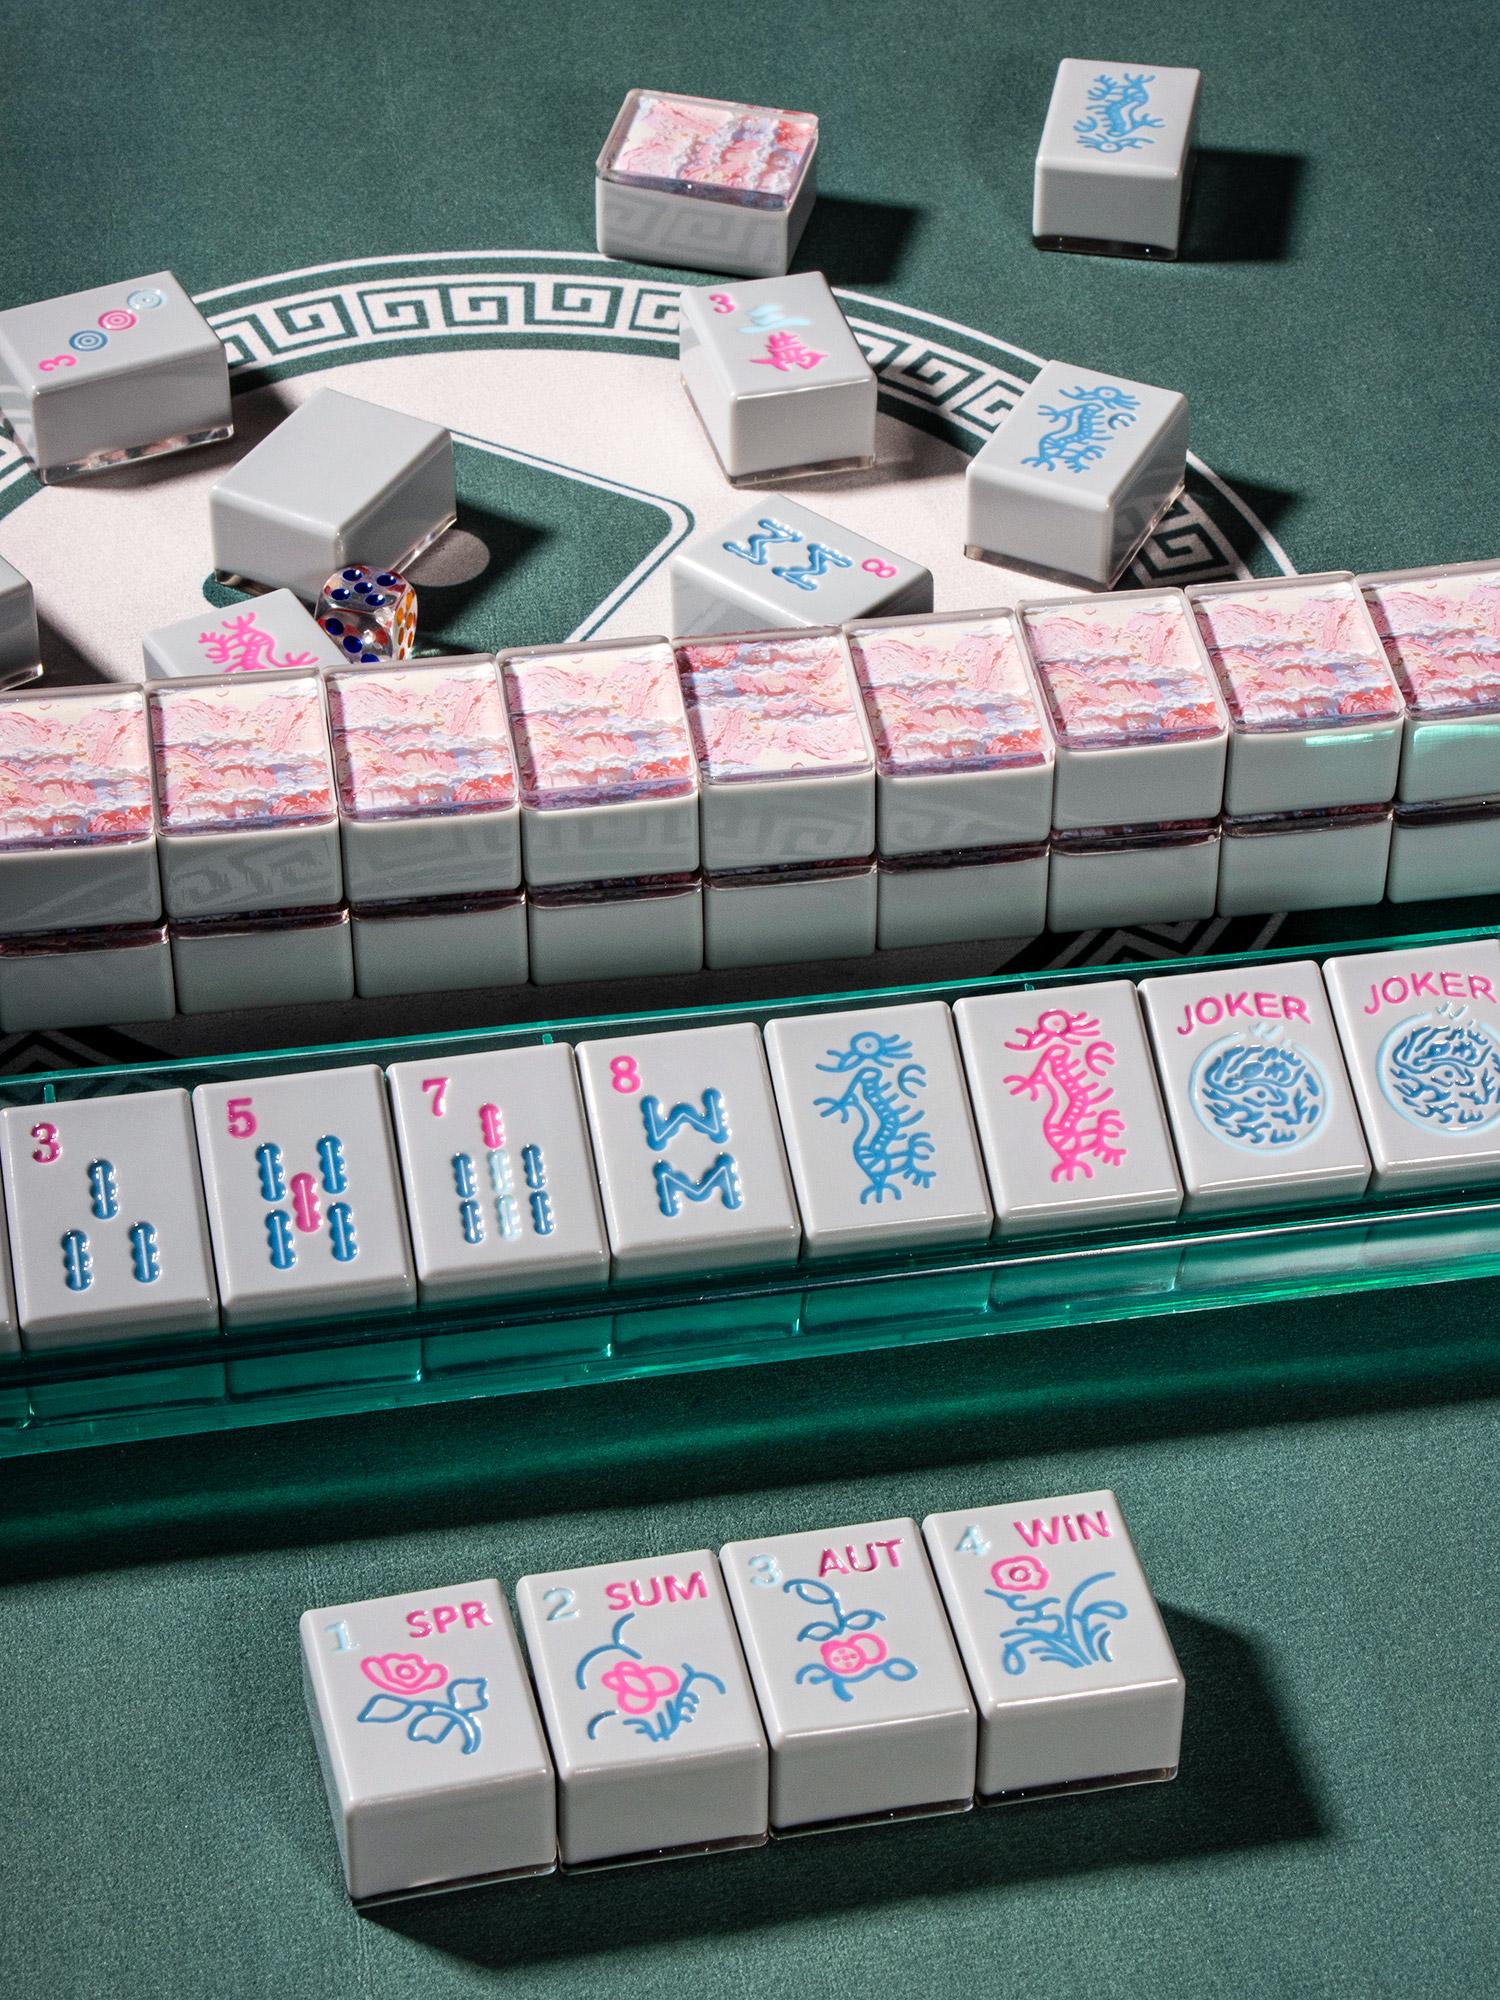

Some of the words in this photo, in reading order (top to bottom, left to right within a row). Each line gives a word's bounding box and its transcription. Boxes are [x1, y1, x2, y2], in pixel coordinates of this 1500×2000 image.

[708, 293, 736, 315] 3
[38, 353, 77, 373] 3
[861, 558, 897, 579] 8
[1177, 991, 1311, 1036] JOKER
[1363, 971, 1497, 1015] JOKER
[421, 1076, 450, 1118] 7
[609, 1055, 643, 1095] 8
[226, 1096, 258, 1140] 5
[30, 1122, 62, 1164] 3
[955, 1525, 990, 1556] 4
[1012, 1510, 1113, 1549] WIN
[749, 1554, 782, 1586] 3
[818, 1537, 904, 1578] AUT
[543, 1587, 580, 1622] 2
[604, 1571, 708, 1611] SUM
[324, 1620, 360, 1651] 1
[405, 1600, 494, 1639] SPR
